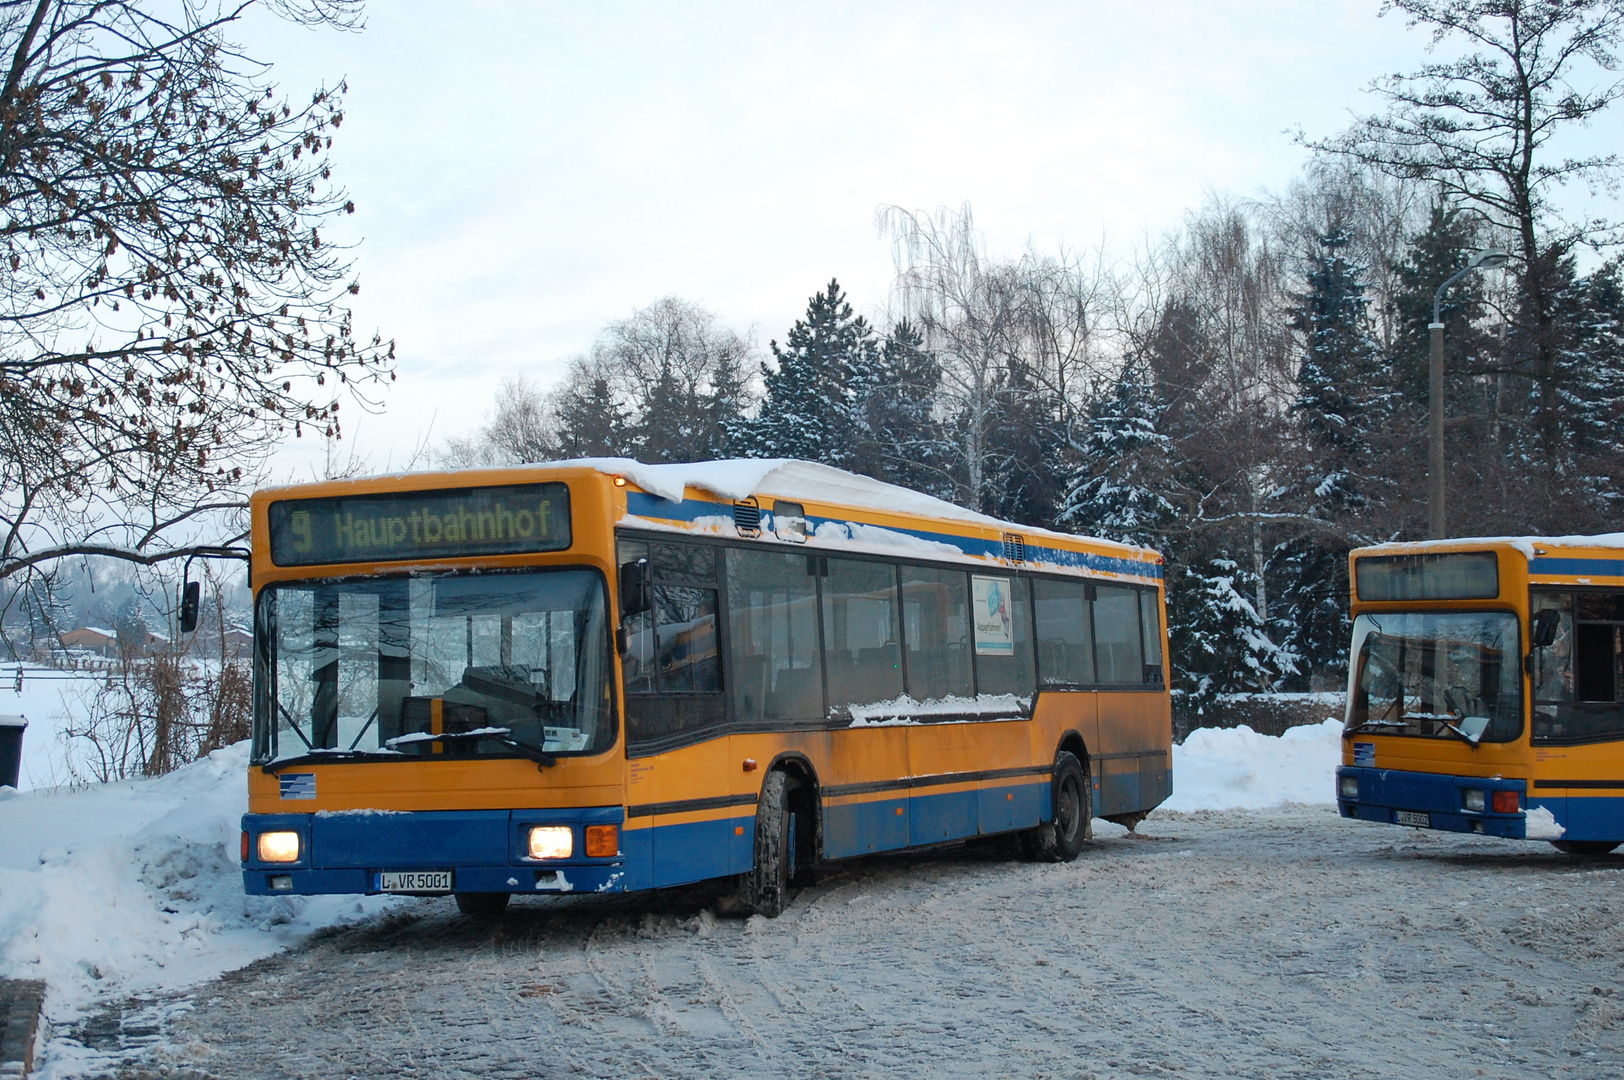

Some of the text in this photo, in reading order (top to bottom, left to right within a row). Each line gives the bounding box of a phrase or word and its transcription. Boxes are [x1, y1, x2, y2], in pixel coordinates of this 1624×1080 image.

[290, 499, 551, 552] 9 Hauptbahnhof
[382, 873, 449, 889] L VR 5001
